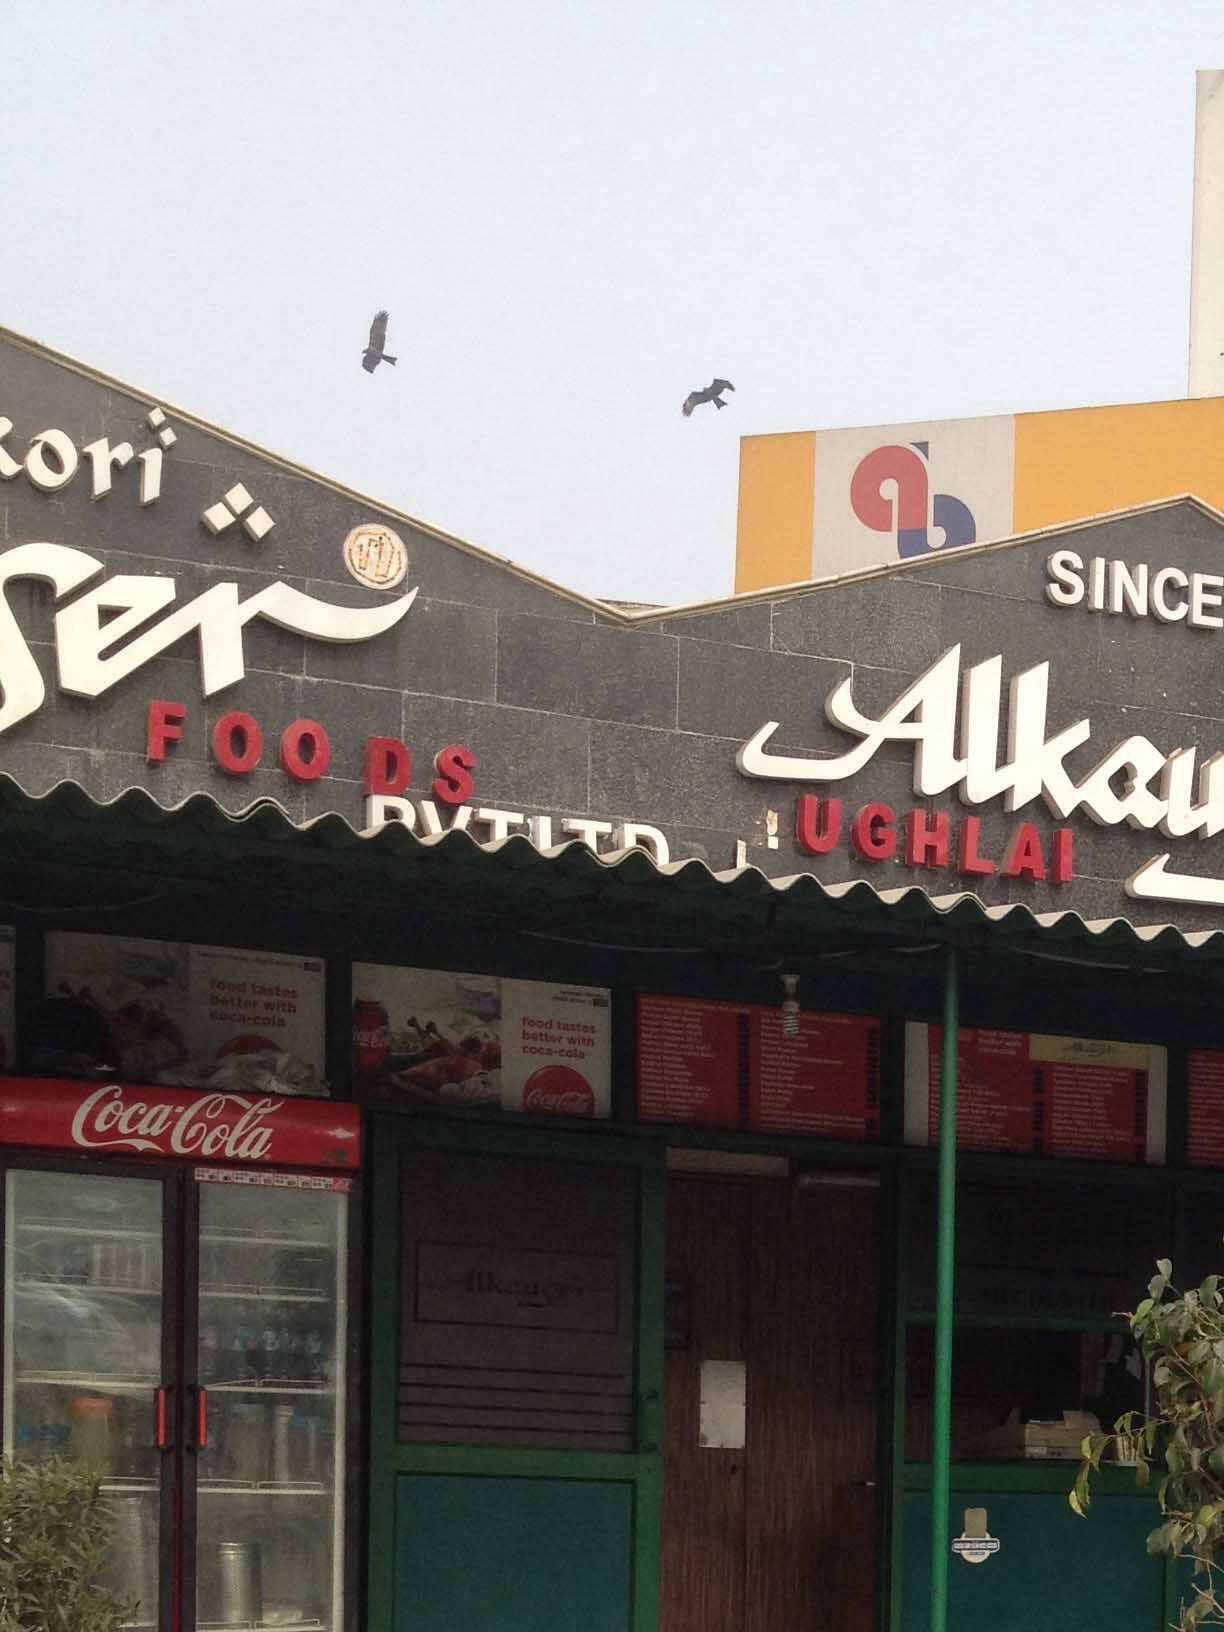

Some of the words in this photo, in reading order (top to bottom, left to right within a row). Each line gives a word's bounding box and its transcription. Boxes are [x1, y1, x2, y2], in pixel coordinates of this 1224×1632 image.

[1045, 550, 1224, 630] SINCE
[146, 701, 478, 804] FOODS
[798, 793, 1073, 885] UGHLAI
[522, 1016, 553, 1030] food
[522, 1030, 563, 1044] better
[567, 1035, 595, 1048] with
[72, 1085, 284, 1160] Coca-Cola
